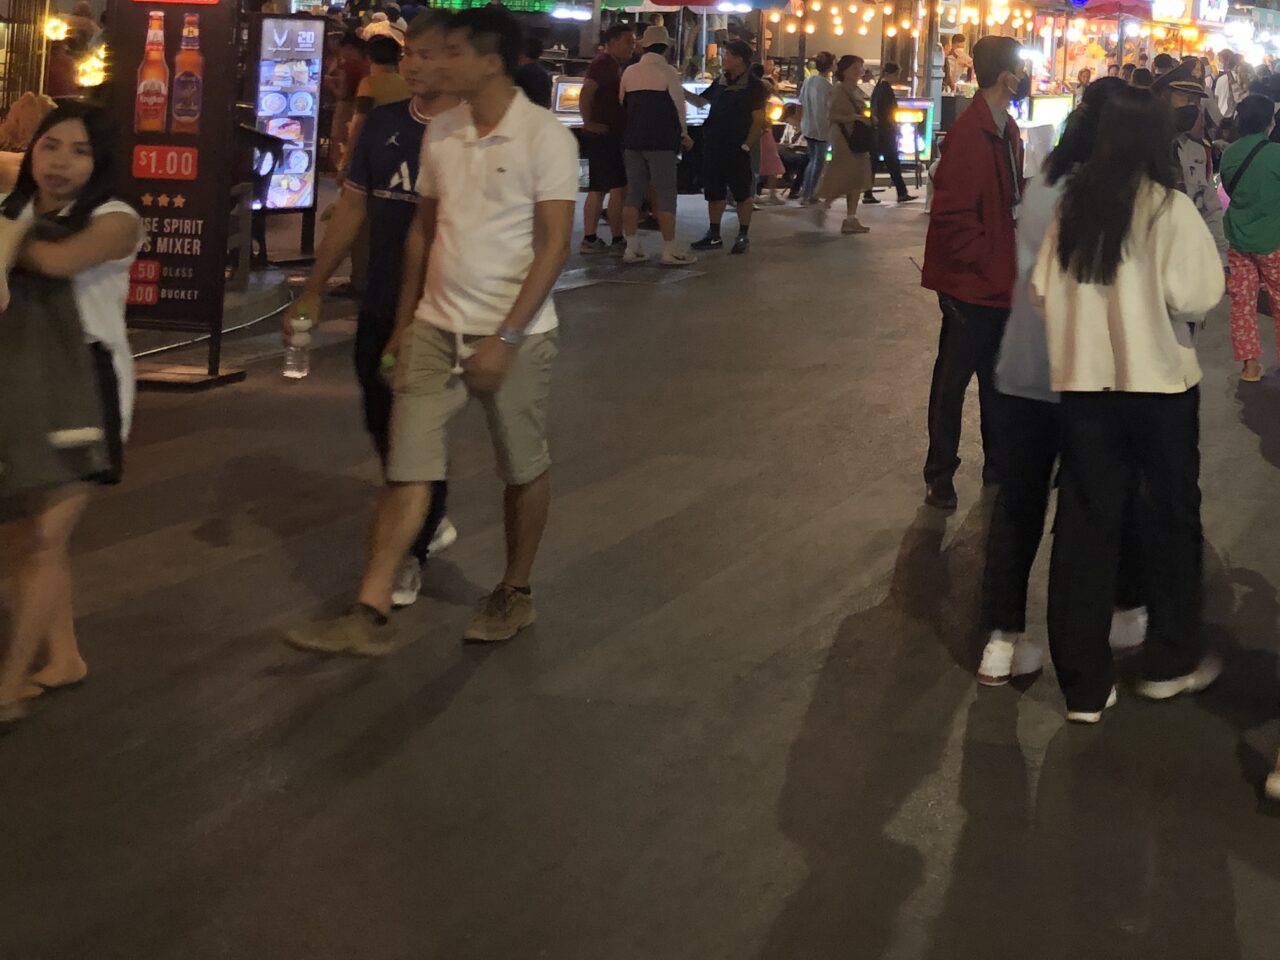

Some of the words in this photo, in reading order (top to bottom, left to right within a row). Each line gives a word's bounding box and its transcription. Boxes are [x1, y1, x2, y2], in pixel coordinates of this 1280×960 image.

[138, 150, 193, 175] $1.00
[163, 218, 204, 235] SPIRIT
[157, 238, 201, 255] MIXER
[160, 289, 199, 301] BUCKET
